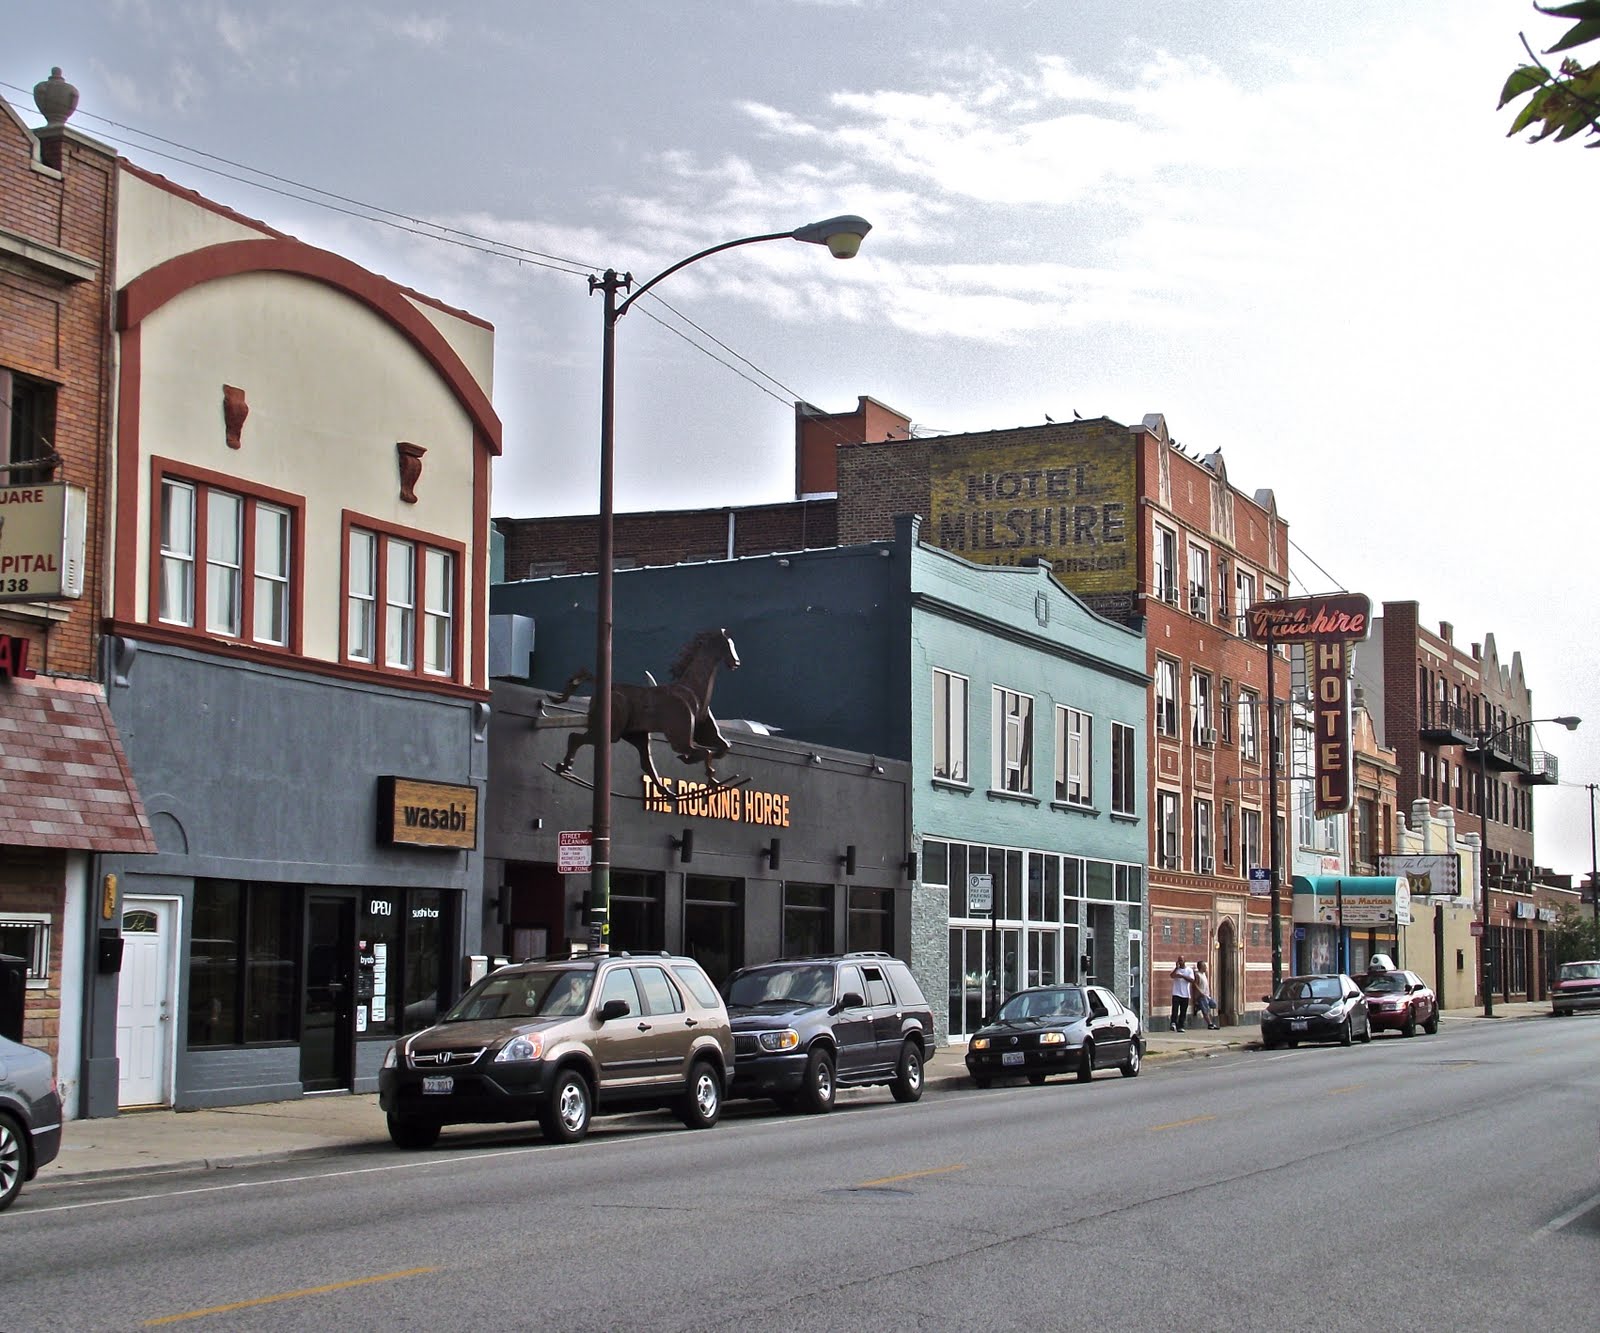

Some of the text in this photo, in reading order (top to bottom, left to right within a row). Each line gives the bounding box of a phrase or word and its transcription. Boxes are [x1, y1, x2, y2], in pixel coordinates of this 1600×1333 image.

[966, 461, 1099, 501] HOTEL
[939, 503, 1126, 551] MILSHIRE
[1319, 643, 1342, 802] HOTEL
[404, 802, 467, 832] wasabi
[643, 774, 790, 827] THE ROCKING HORSE
